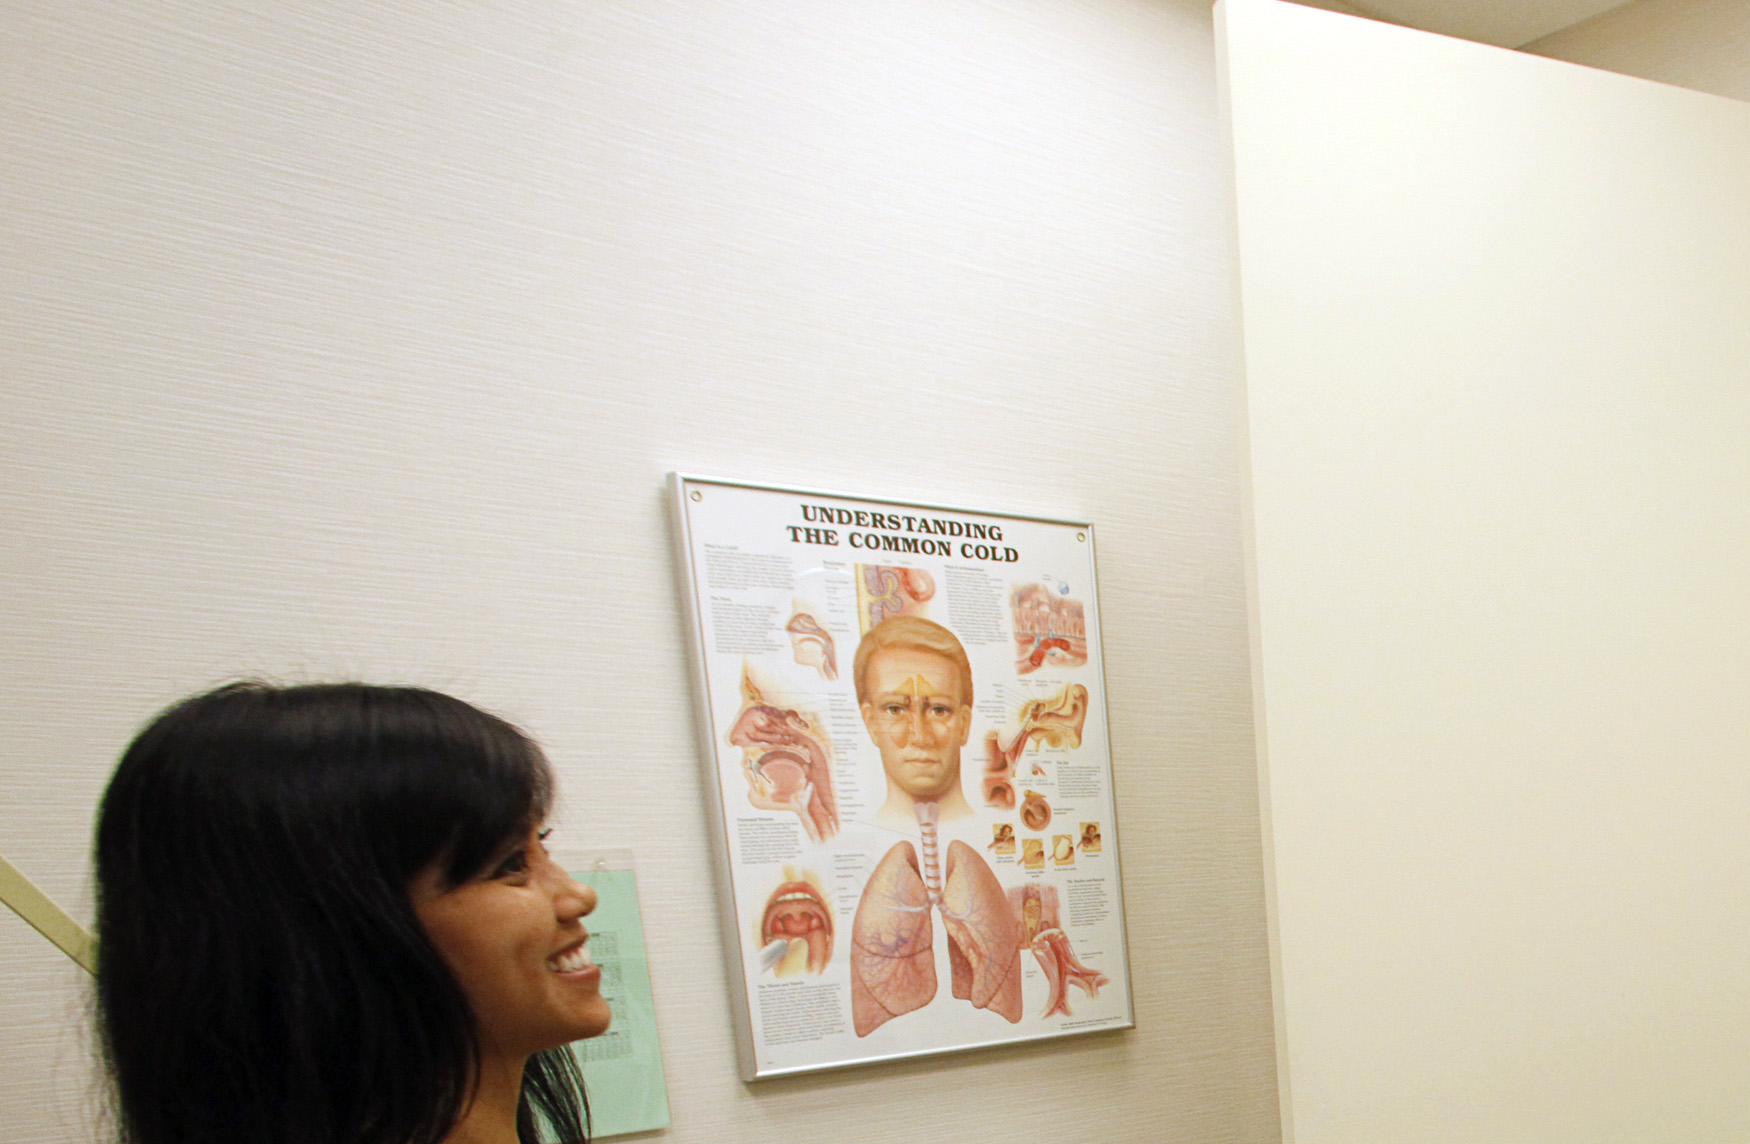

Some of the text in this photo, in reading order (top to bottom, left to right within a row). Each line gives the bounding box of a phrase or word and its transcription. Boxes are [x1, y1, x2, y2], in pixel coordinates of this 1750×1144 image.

[800, 504, 1003, 542] UNDERSTANDING
[787, 525, 1019, 563] THE COMMON COLD
